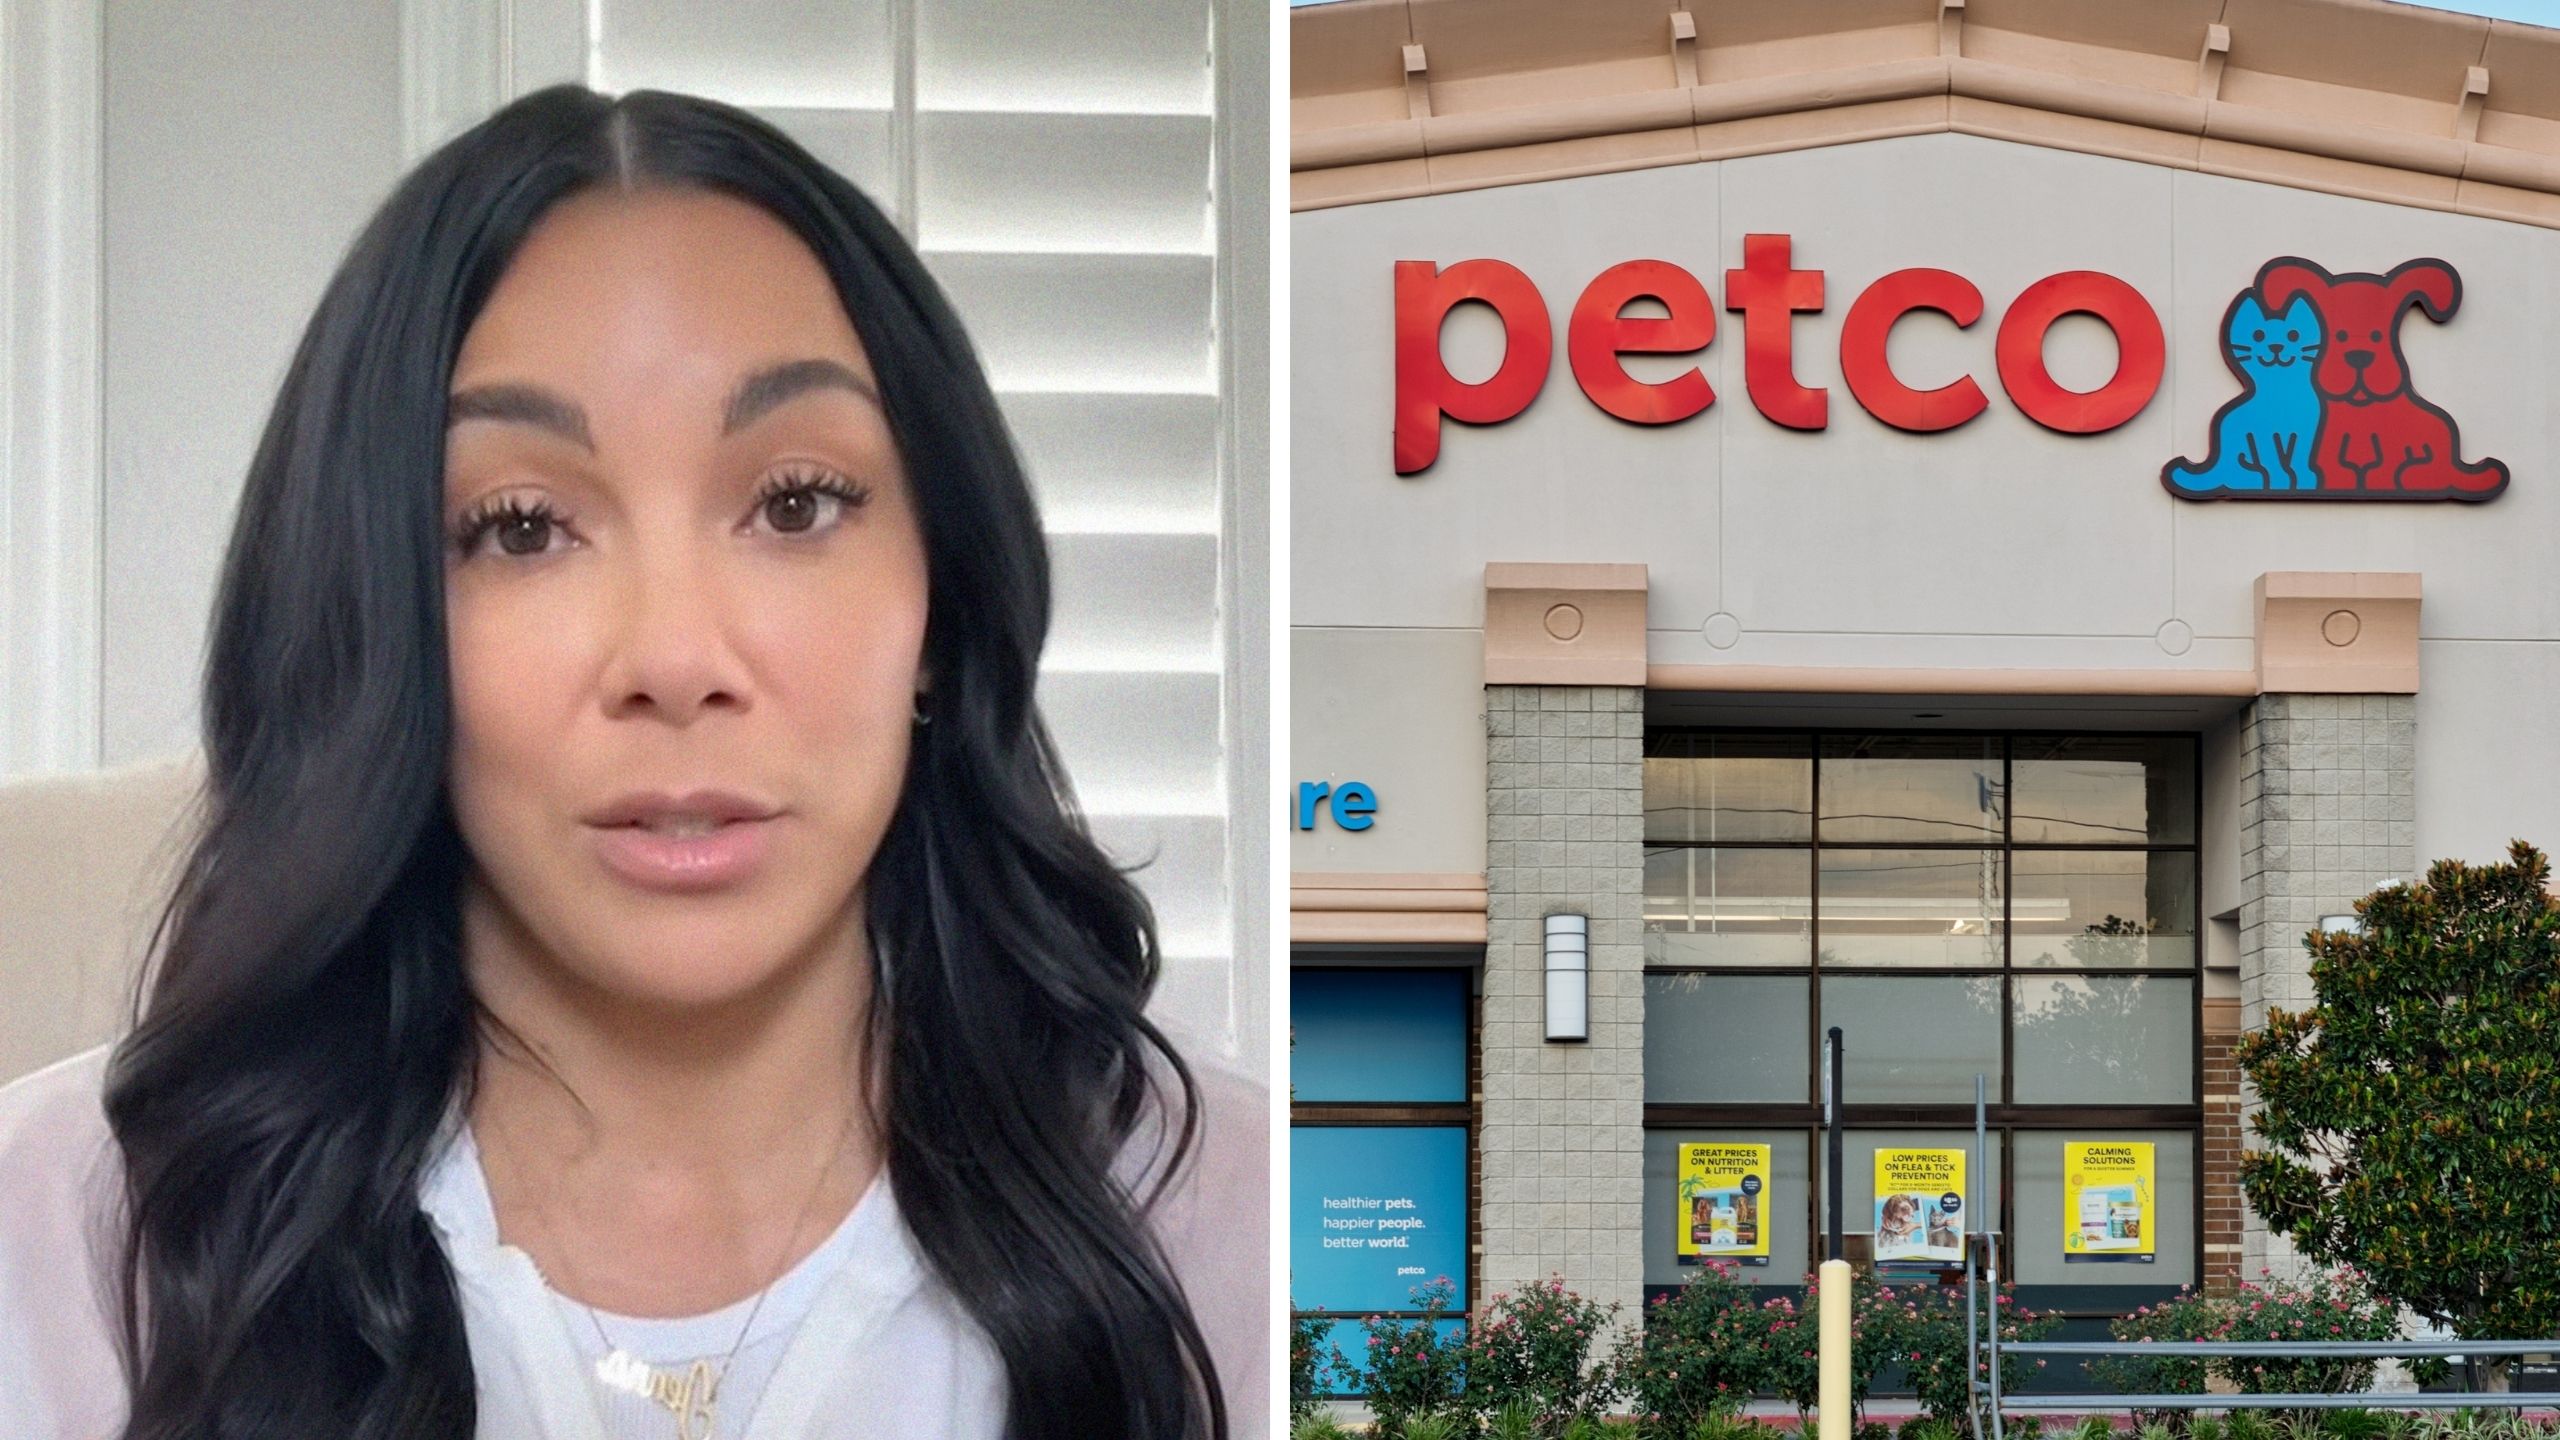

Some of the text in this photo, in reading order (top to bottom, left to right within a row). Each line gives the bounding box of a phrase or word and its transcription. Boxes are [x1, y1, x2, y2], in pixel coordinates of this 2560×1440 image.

[1394, 233, 2165, 477] petco
[1289, 781, 1377, 832] re
[1692, 1148, 1758, 1157] GREAT PRICES
[2087, 1148, 2131, 1156] CALMING
[1690, 1157, 1758, 1166] ON NUTRITION
[1892, 1154, 1949, 1163] LOW PRICES
[2083, 1156, 2136, 1165] SOLUTIONS
[1704, 1166, 1744, 1174] & LITTER
[1884, 1163, 1956, 1171] ON FLEA & TICK
[1891, 1172, 1949, 1180] PREVENTION
[1323, 1197, 1416, 1211] healthier pets.
[1323, 1216, 1426, 1231] happier people.
[1323, 1236, 1365, 1248] better
[1397, 1266, 1426, 1276] petco
